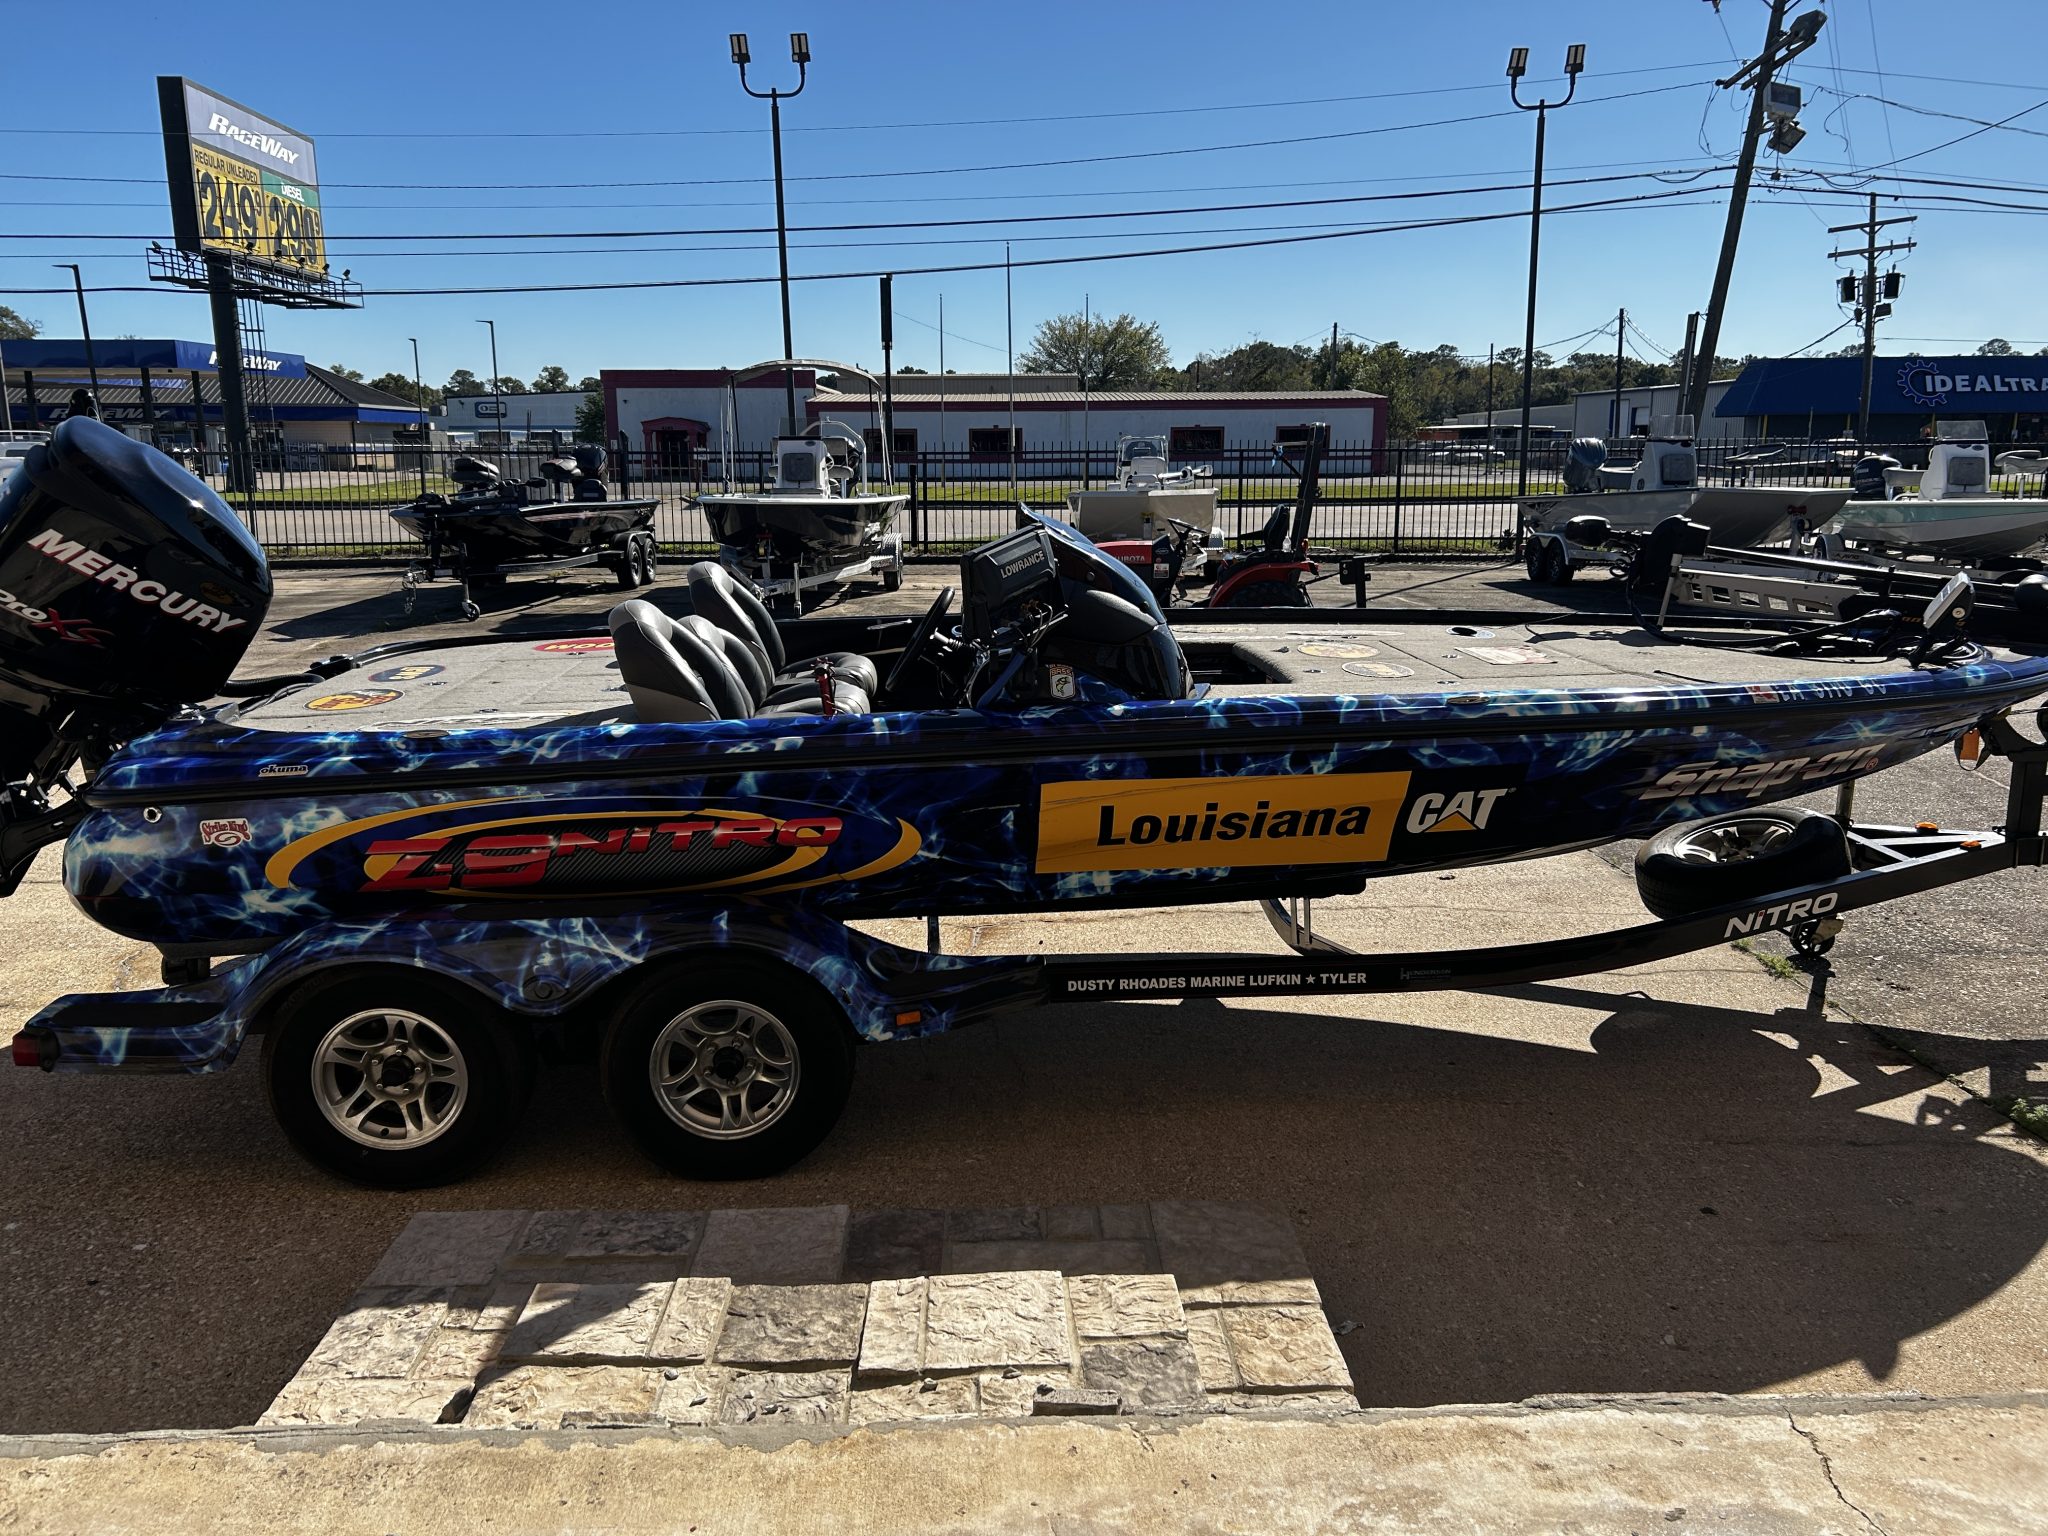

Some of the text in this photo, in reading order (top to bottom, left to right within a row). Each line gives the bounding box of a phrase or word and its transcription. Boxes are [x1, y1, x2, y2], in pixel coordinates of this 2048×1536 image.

[194, 150, 257, 184] REGULAR UNLEADED
[281, 183, 305, 202] DIESEL
[1000, 550, 1045, 578] LOWRANCE
[26, 528, 248, 635] MERCURY
[260, 765, 307, 774] okuma
[1097, 800, 1371, 846] Louisiana
[1406, 788, 1508, 834] CAT
[1067, 972, 1367, 991] DUSTY RHOADES MARINE LUFKIN TYLER
